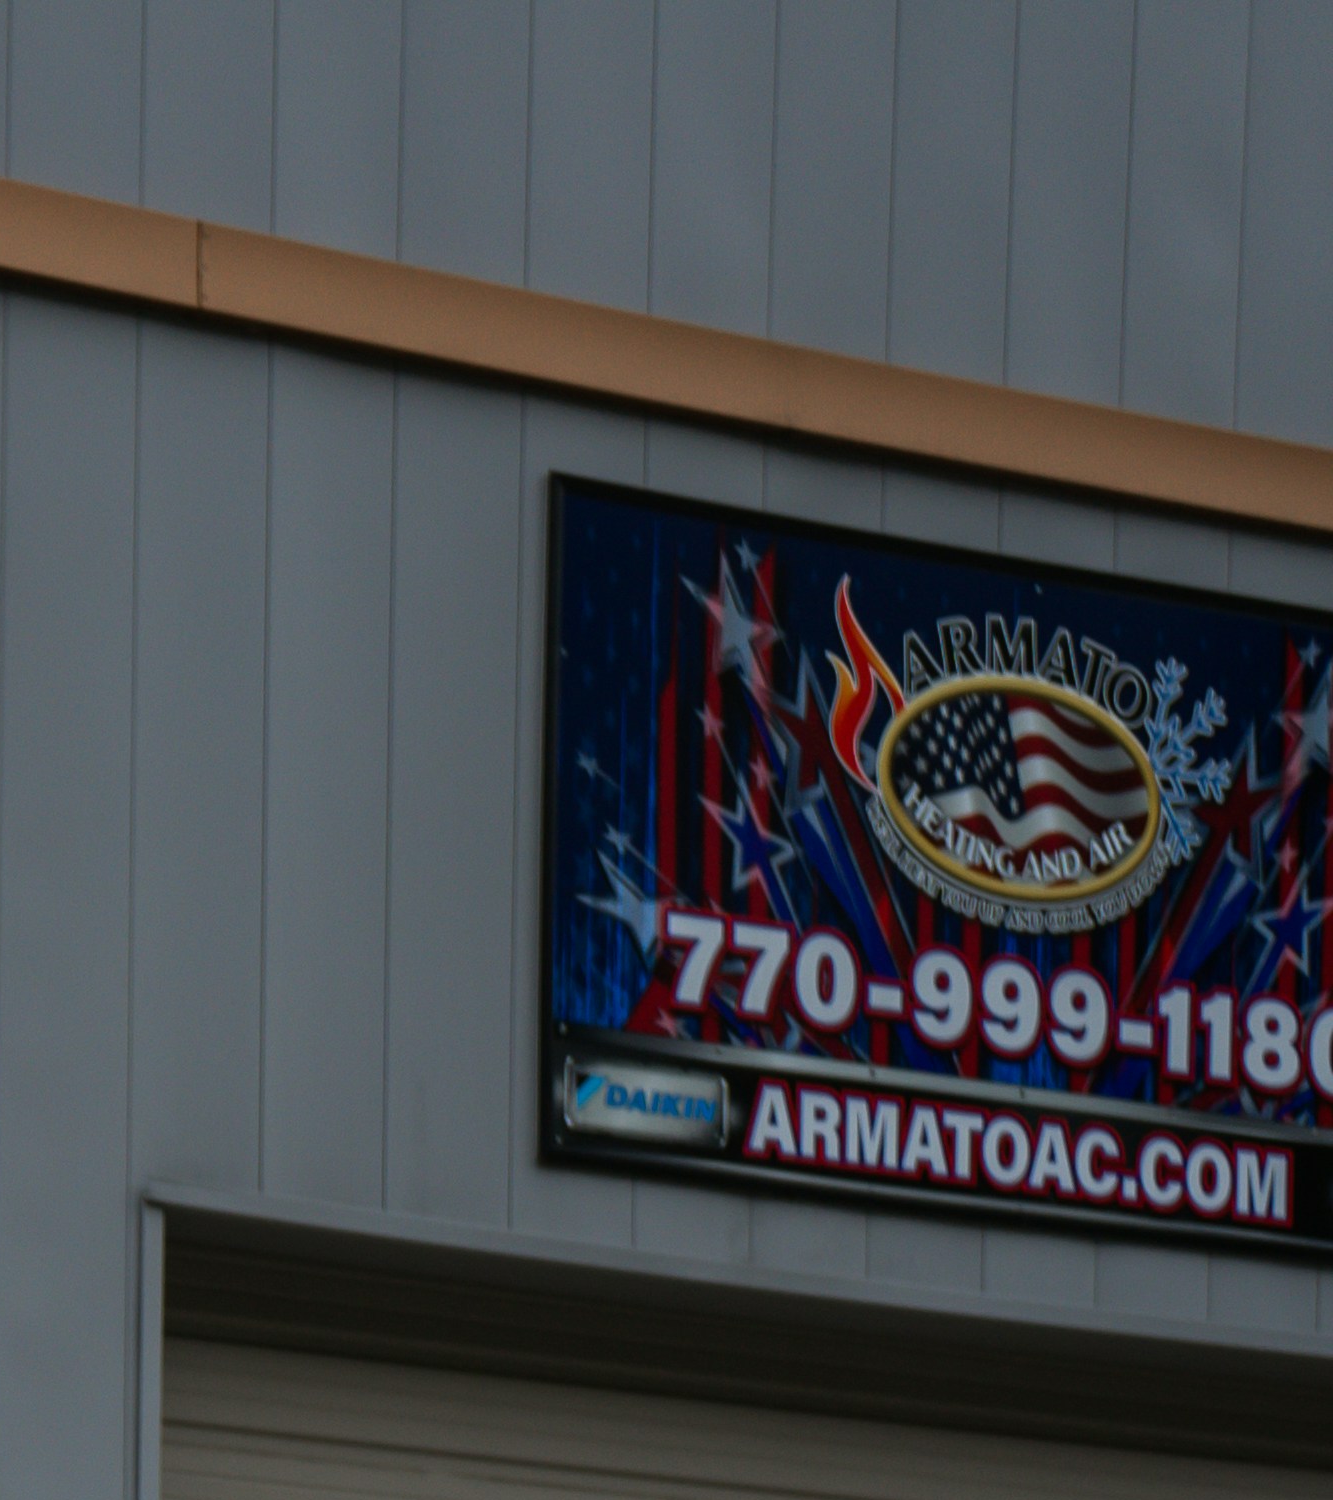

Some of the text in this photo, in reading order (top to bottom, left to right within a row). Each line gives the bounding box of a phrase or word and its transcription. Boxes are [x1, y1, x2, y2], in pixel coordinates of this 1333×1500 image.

[903, 612, 1153, 729] ARMATO
[904, 782, 1016, 880] HEATING
[1022, 848, 1081, 882] AND
[1088, 821, 1134, 871] AIR
[605, 1084, 717, 1122] DAIKIN
[745, 1081, 1291, 1223] ARMATOAC.COM
